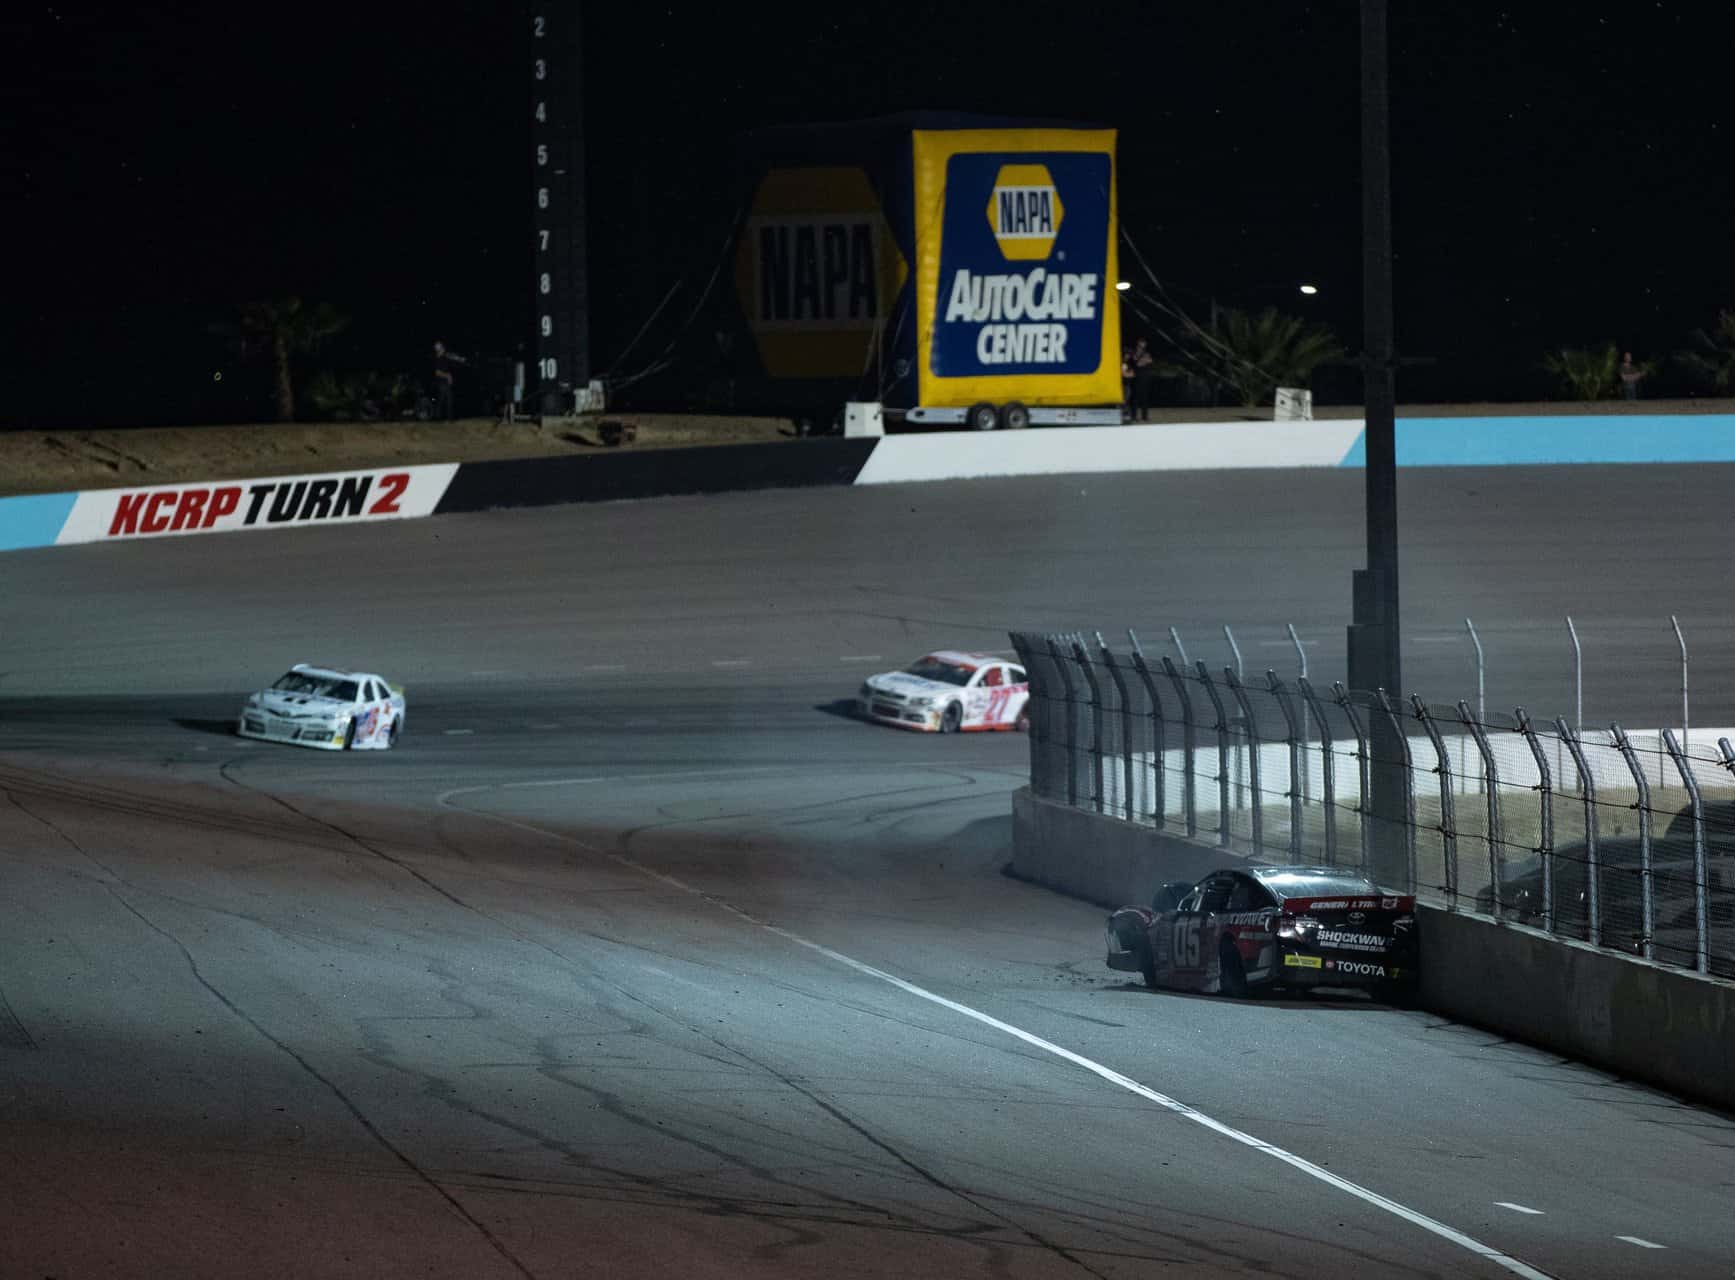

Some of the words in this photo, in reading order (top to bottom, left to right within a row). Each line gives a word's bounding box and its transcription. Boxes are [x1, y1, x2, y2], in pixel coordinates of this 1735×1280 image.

[534, 17, 545, 37] 2
[535, 60, 546, 80] 3
[536, 102, 546, 122] 4
[537, 145, 548, 165] 5
[538, 188, 549, 208] 6
[1000, 190, 1053, 234] NAPA
[539, 230, 550, 250] 7
[759, 222, 877, 320] NAPA
[540, 273, 551, 294] 8
[541, 315, 552, 337] 9
[977, 324, 1067, 364] CENTER
[538, 358, 558, 379] 10
[108, 486, 242, 536] KCRP
[243, 476, 374, 525] TURN
[367, 473, 411, 514] 2
[1336, 960, 1385, 977] TOYOTA
